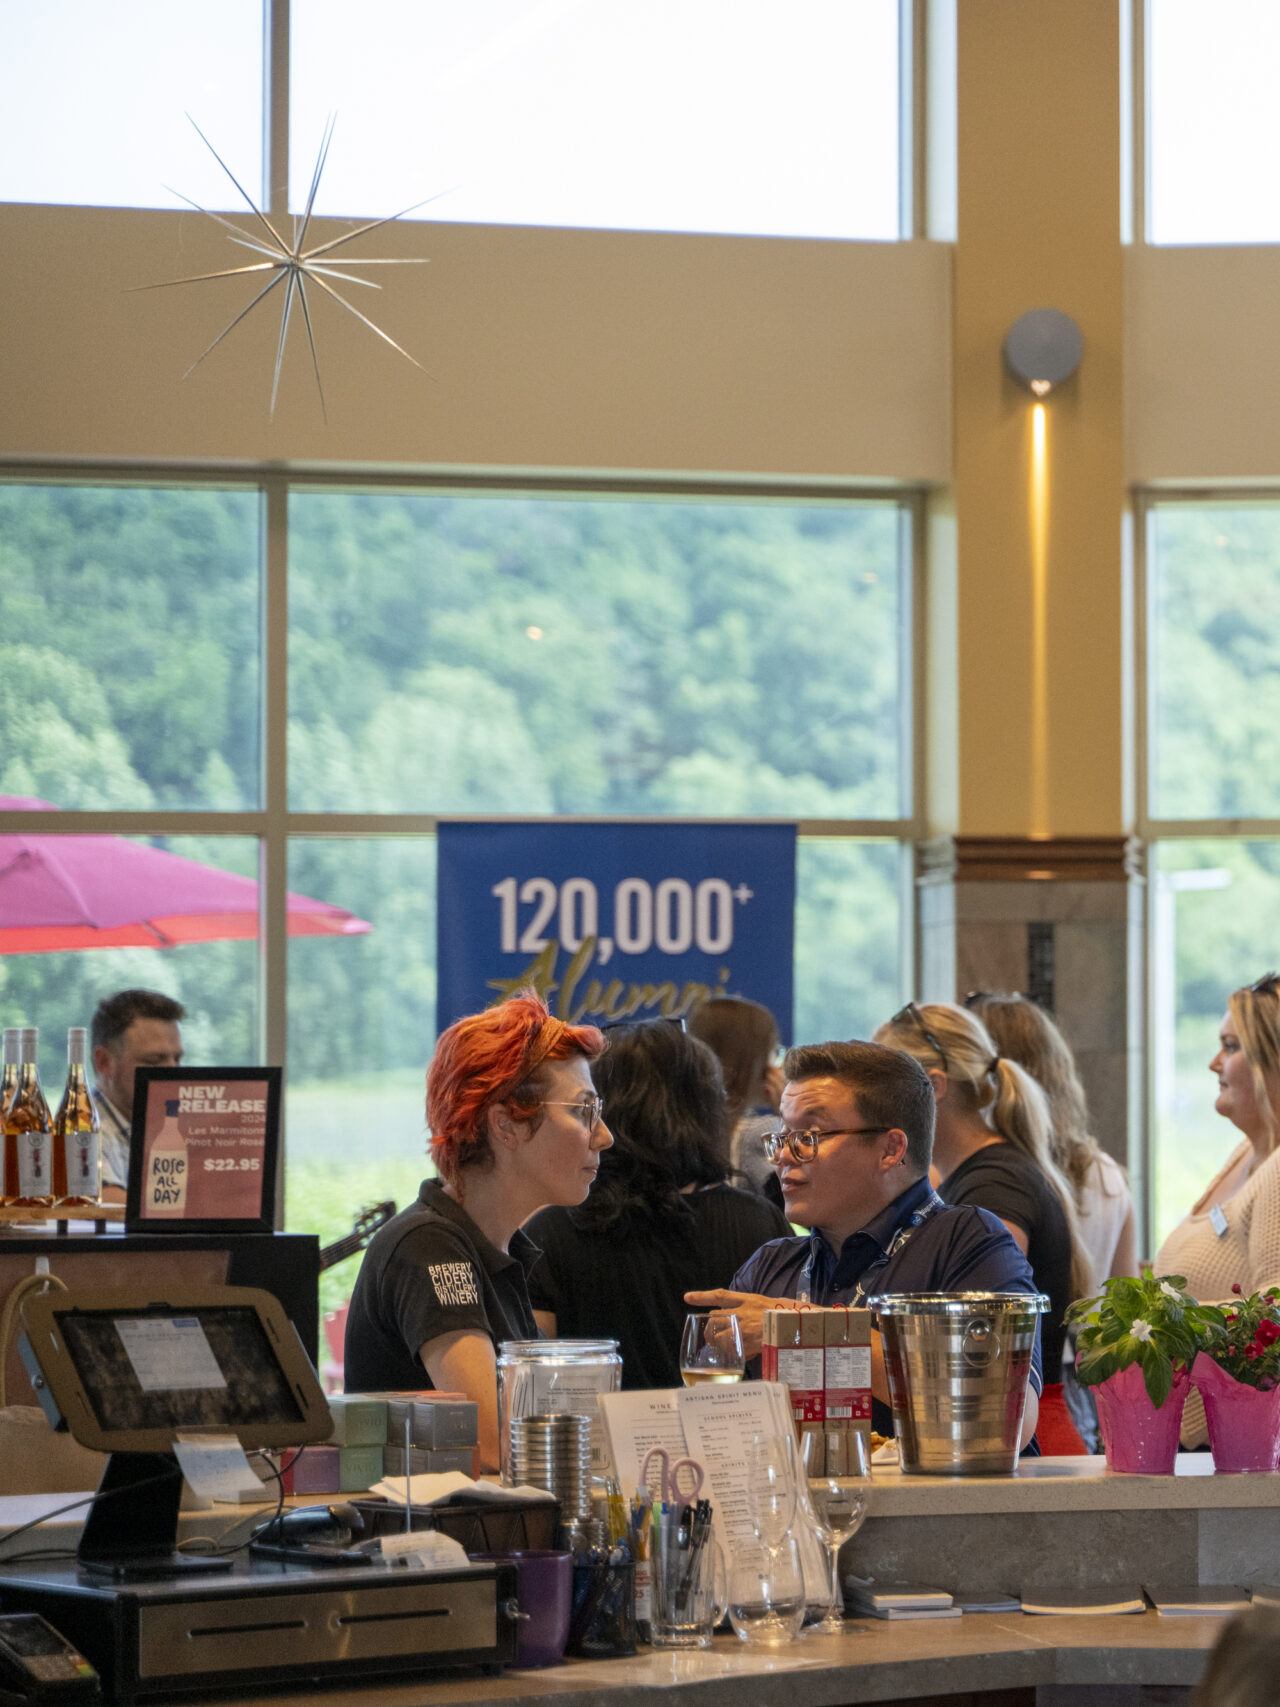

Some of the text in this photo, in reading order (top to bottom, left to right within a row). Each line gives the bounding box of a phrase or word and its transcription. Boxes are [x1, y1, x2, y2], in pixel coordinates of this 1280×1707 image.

[179, 1086, 225, 1099] NEW
[178, 1100, 265, 1113] RELEASE
[203, 1158, 261, 1171] $22.95
[156, 1176, 178, 1188] ALL
[153, 1188, 181, 1204] DAY
[428, 1262, 471, 1276] BREWERY
[431, 1271, 473, 1286] CIDERY
[434, 1284, 476, 1294] DISTILLERY
[436, 1292, 478, 1306] WINERY
